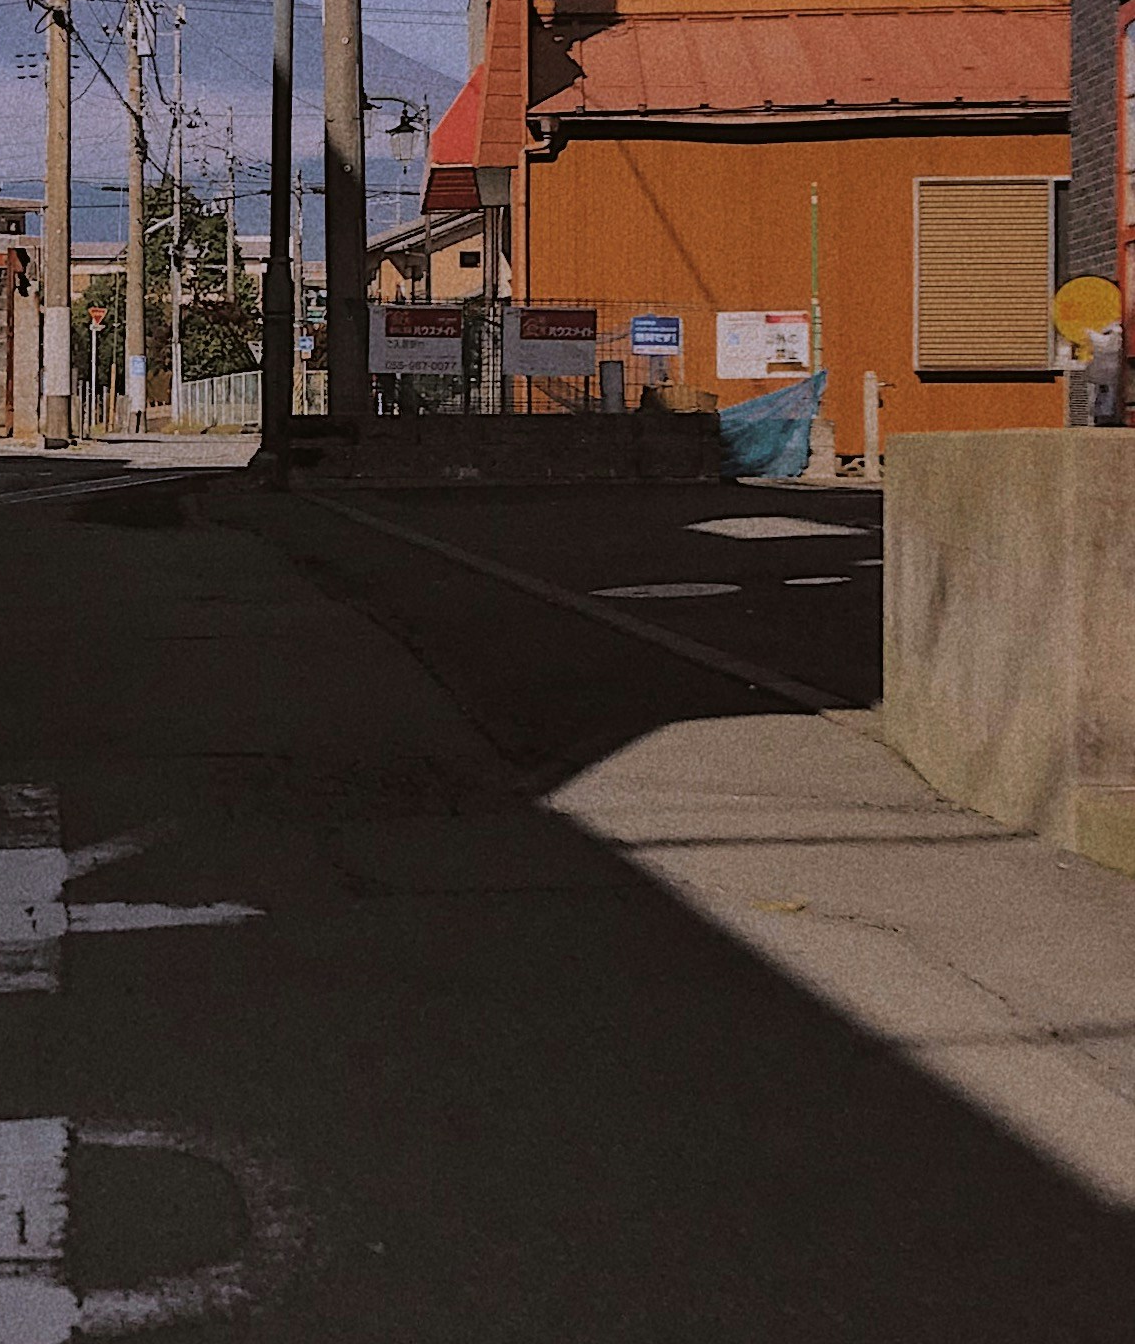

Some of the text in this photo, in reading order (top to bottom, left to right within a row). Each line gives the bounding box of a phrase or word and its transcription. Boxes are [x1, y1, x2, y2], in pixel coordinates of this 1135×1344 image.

[413, 326, 457, 336] ハウスメイト
